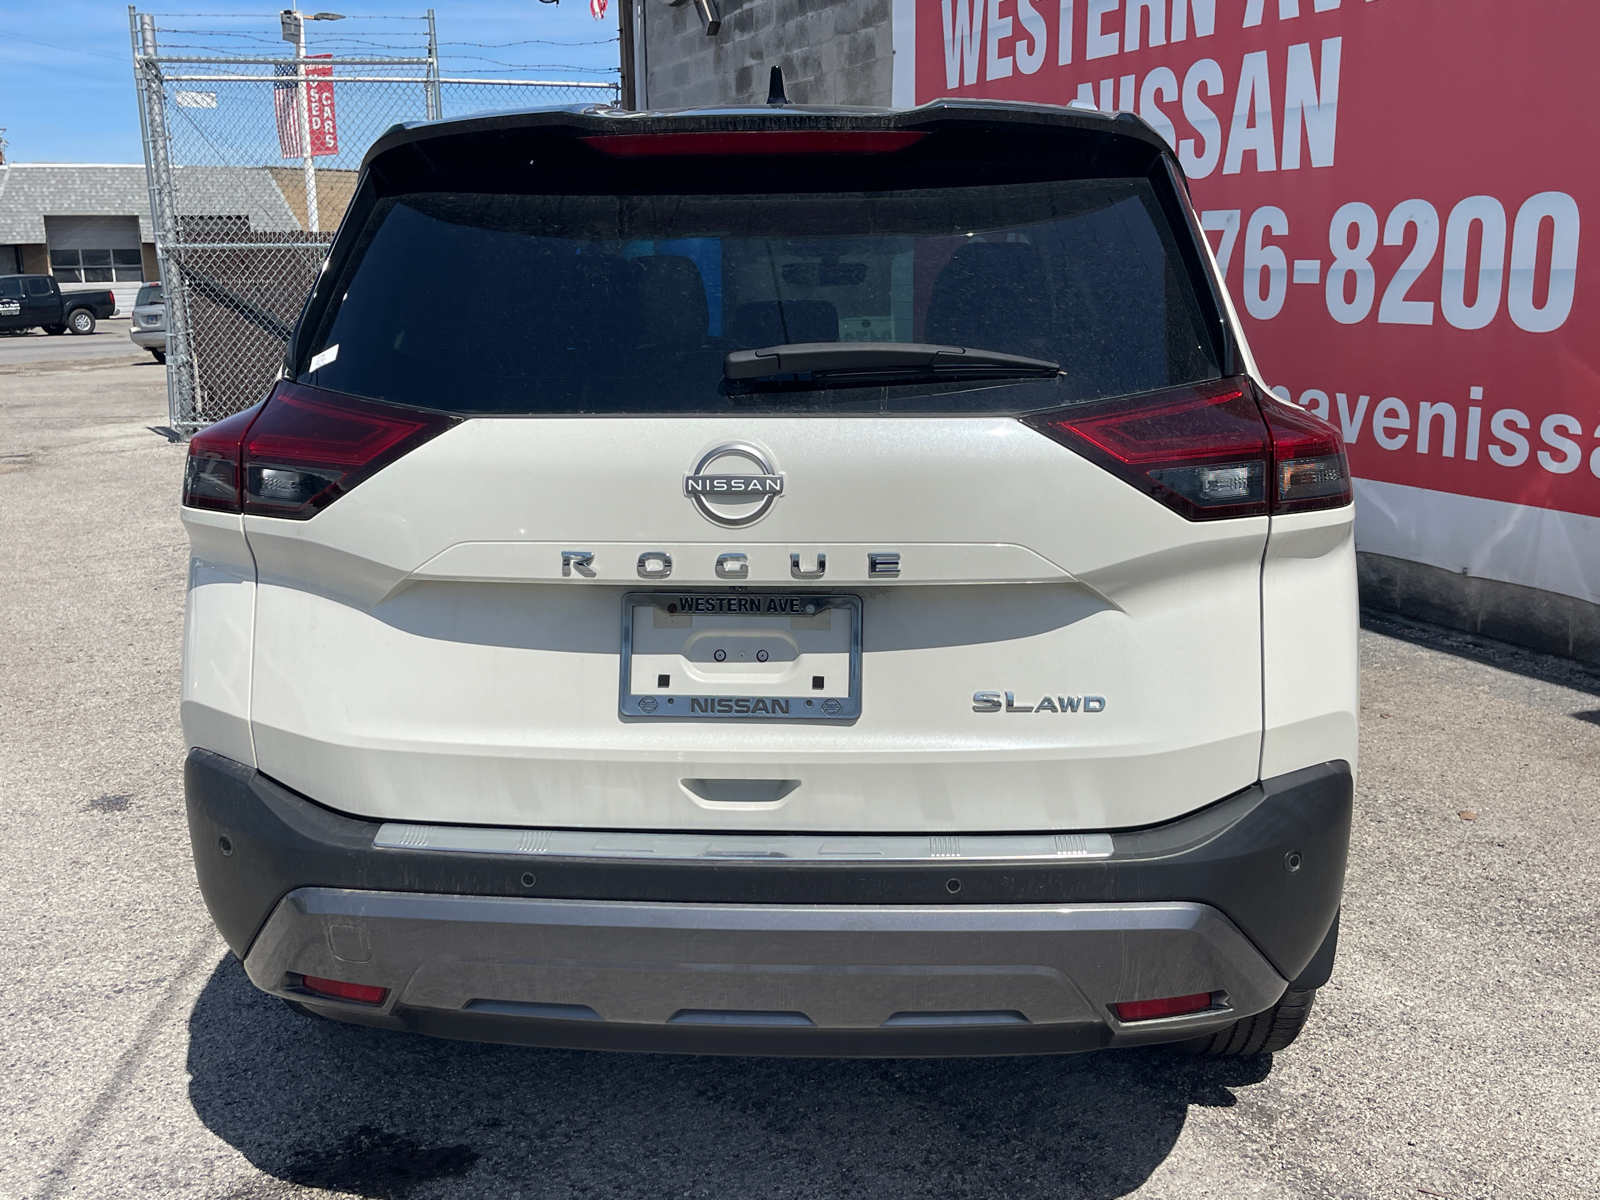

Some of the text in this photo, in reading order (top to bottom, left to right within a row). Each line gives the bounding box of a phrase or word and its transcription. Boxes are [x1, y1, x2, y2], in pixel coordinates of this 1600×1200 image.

[321, 92, 335, 148] CARS
[1076, 36, 1343, 180] SSAN
[1268, 385, 1600, 480] aveniss
[688, 479, 781, 491] NISSAN
[561, 550, 902, 579] ROGUE
[679, 596, 805, 614] WESTERN AVE.
[690, 698, 790, 715] NISSAN
